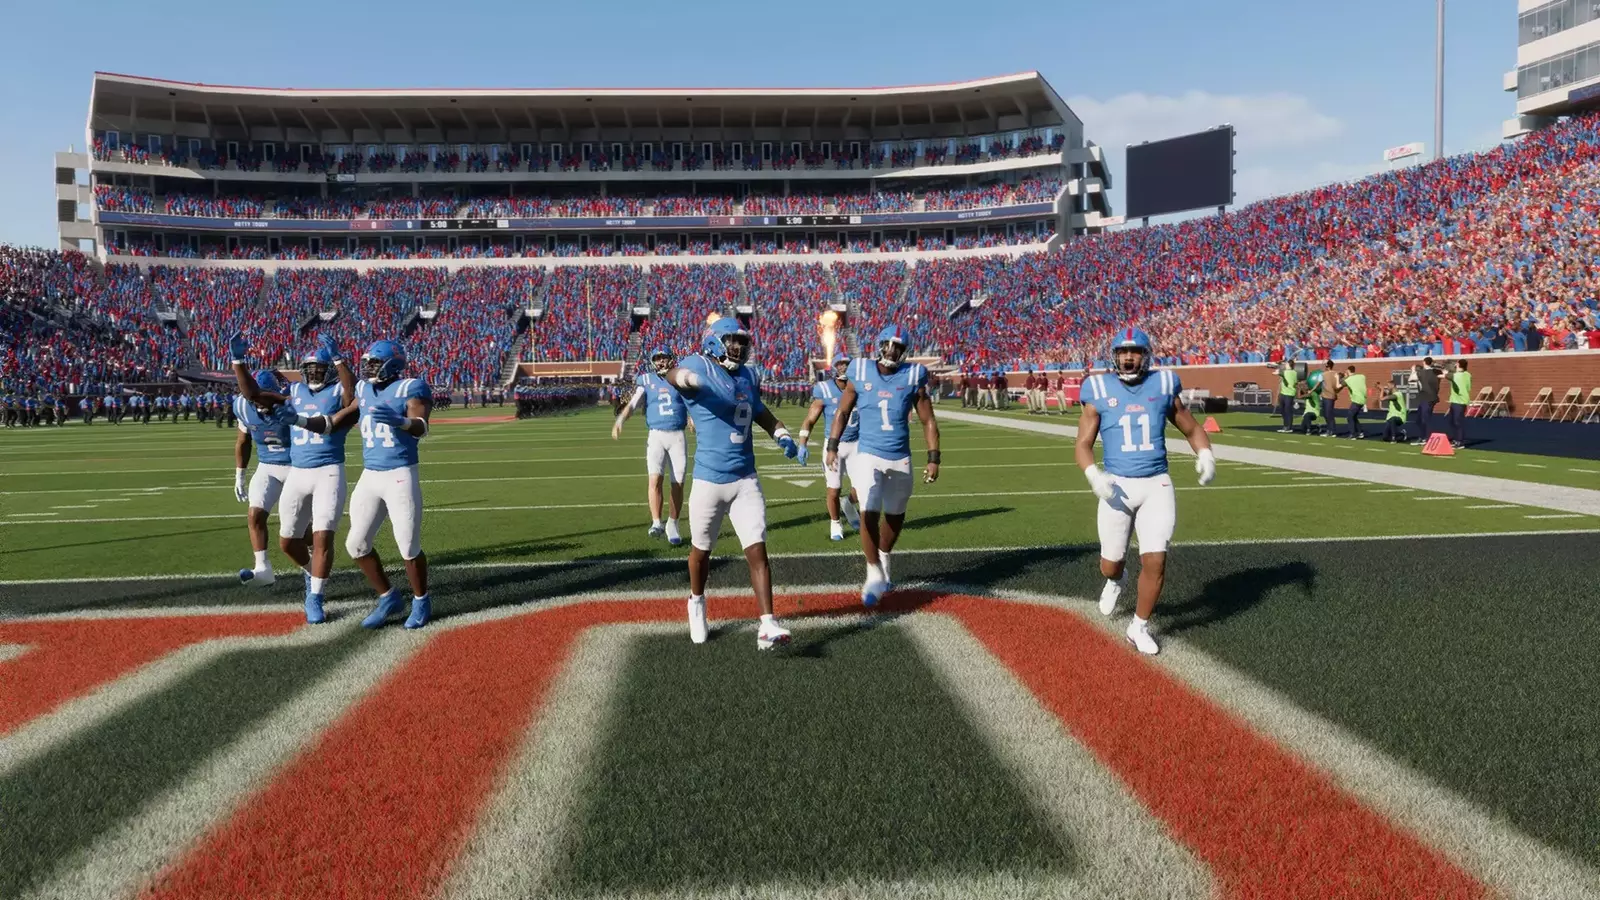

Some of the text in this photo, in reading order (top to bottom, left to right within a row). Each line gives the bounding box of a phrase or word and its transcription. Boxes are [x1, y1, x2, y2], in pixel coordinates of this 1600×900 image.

[430, 220, 448, 229] 5:00
[658, 393, 674, 416] 2
[878, 400, 894, 431] 1
[361, 415, 395, 448] 44
[730, 402, 752, 444] 9
[1118, 414, 1154, 452] 11
[264, 436, 286, 452] 2
[1427, 436, 1441, 452] 10
